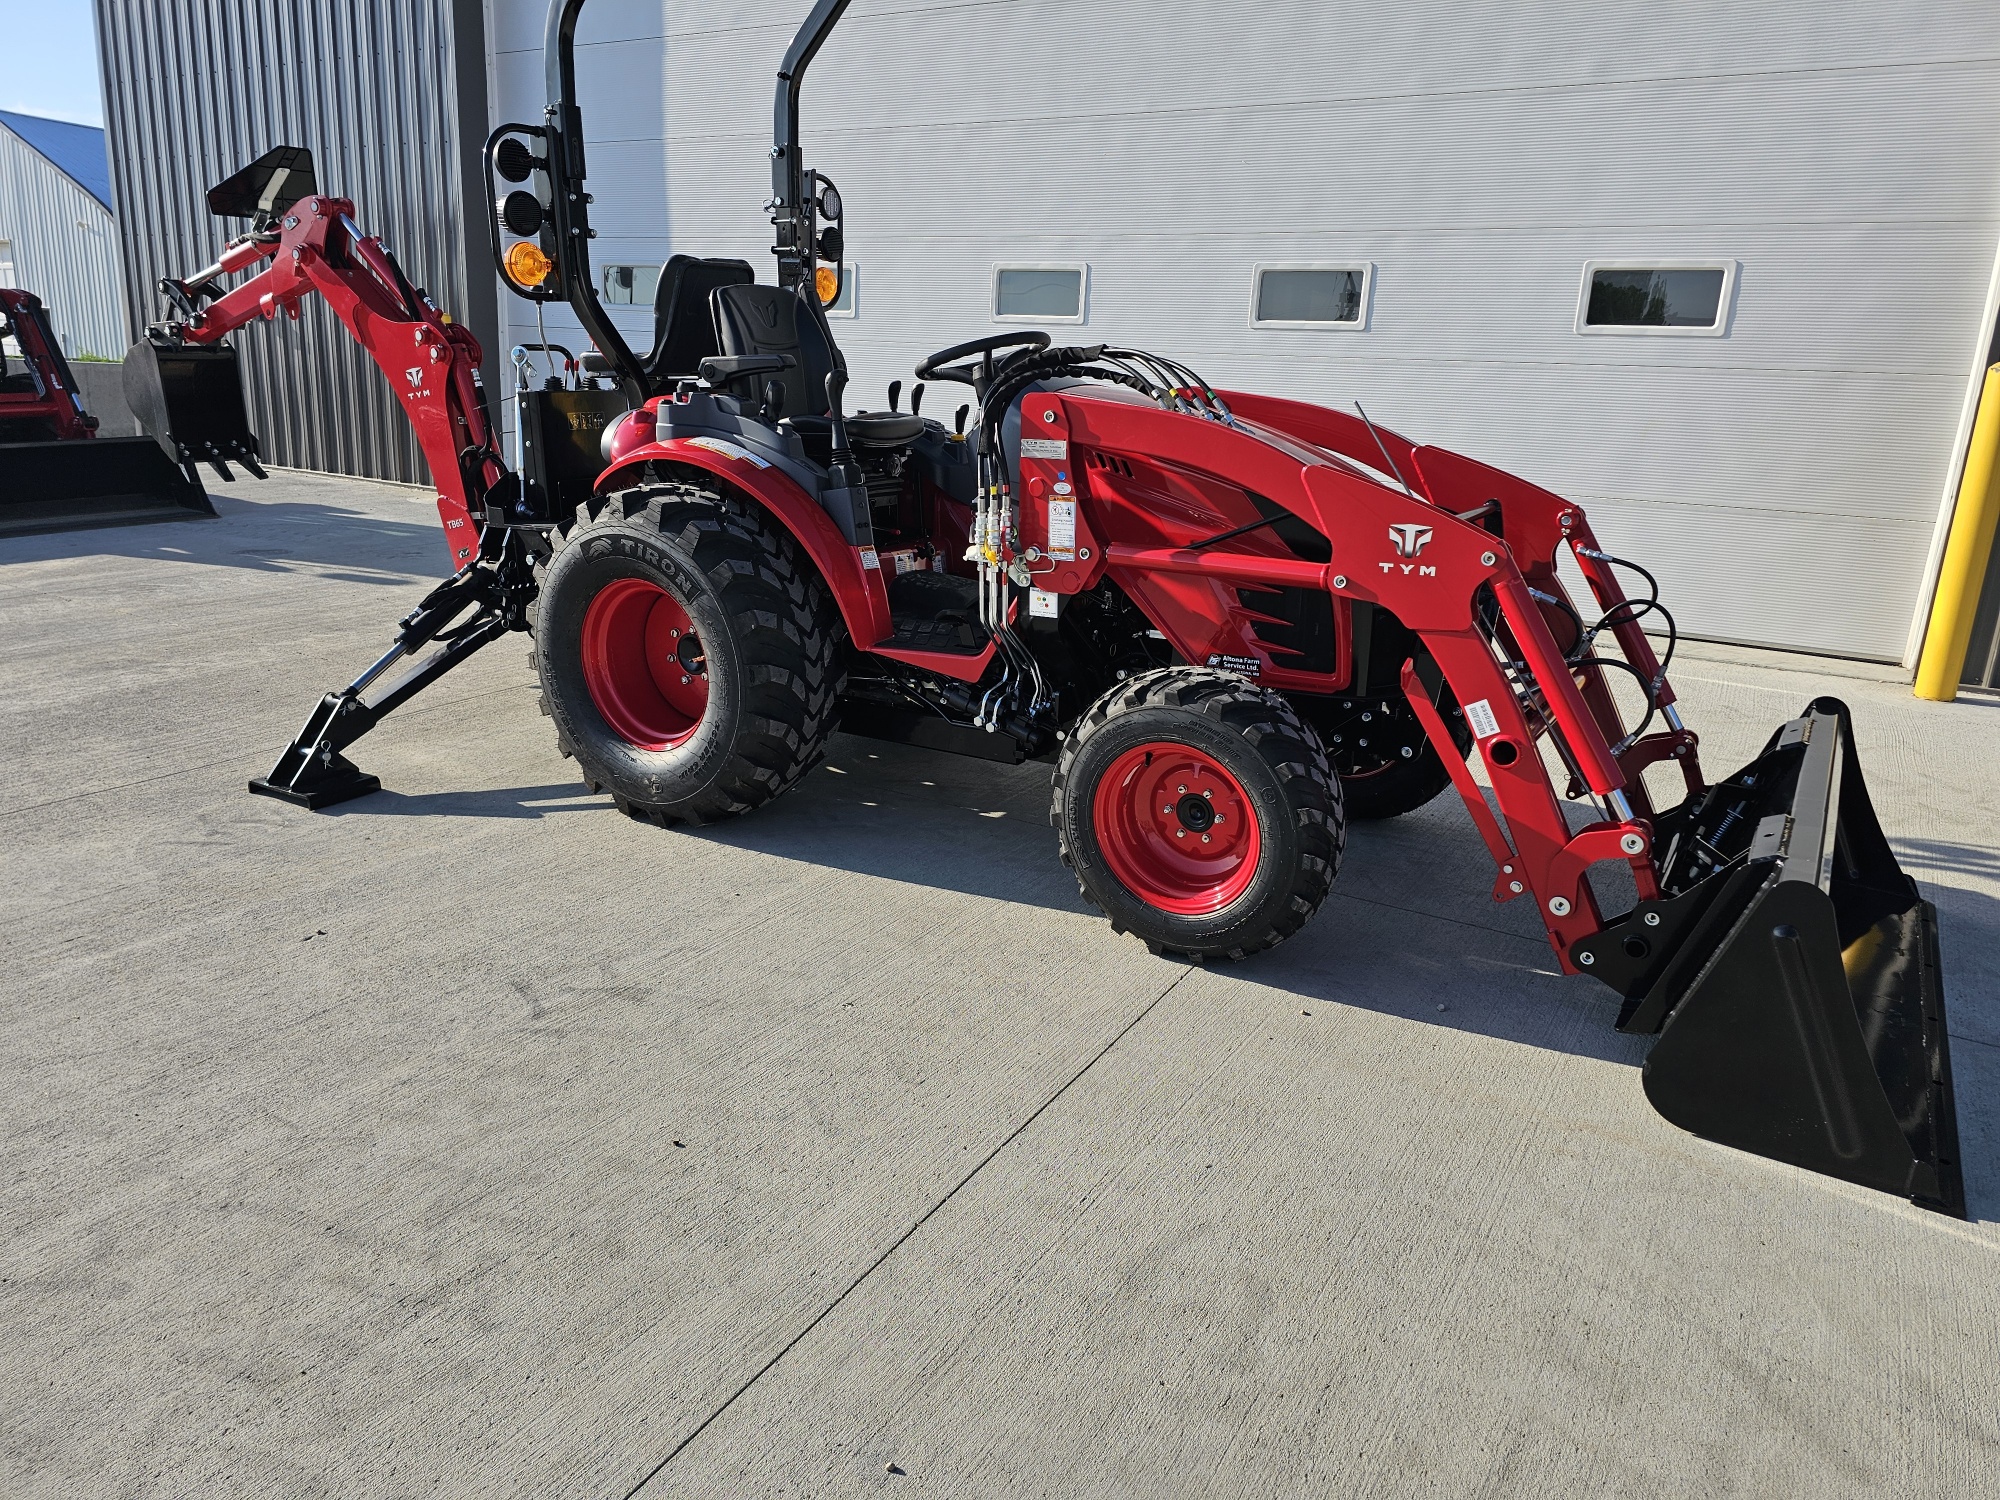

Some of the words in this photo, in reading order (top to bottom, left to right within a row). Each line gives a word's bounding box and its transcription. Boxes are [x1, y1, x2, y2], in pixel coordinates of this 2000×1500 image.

[408, 389, 430, 401] TYM
[447, 518, 464, 530] TB65
[620, 538, 692, 595] TIRON
[1378, 562, 1437, 577] TYM
[1222, 655, 1243, 663] Altona
[1244, 657, 1260, 665] Farm
[1223, 661, 1246, 670] Service
